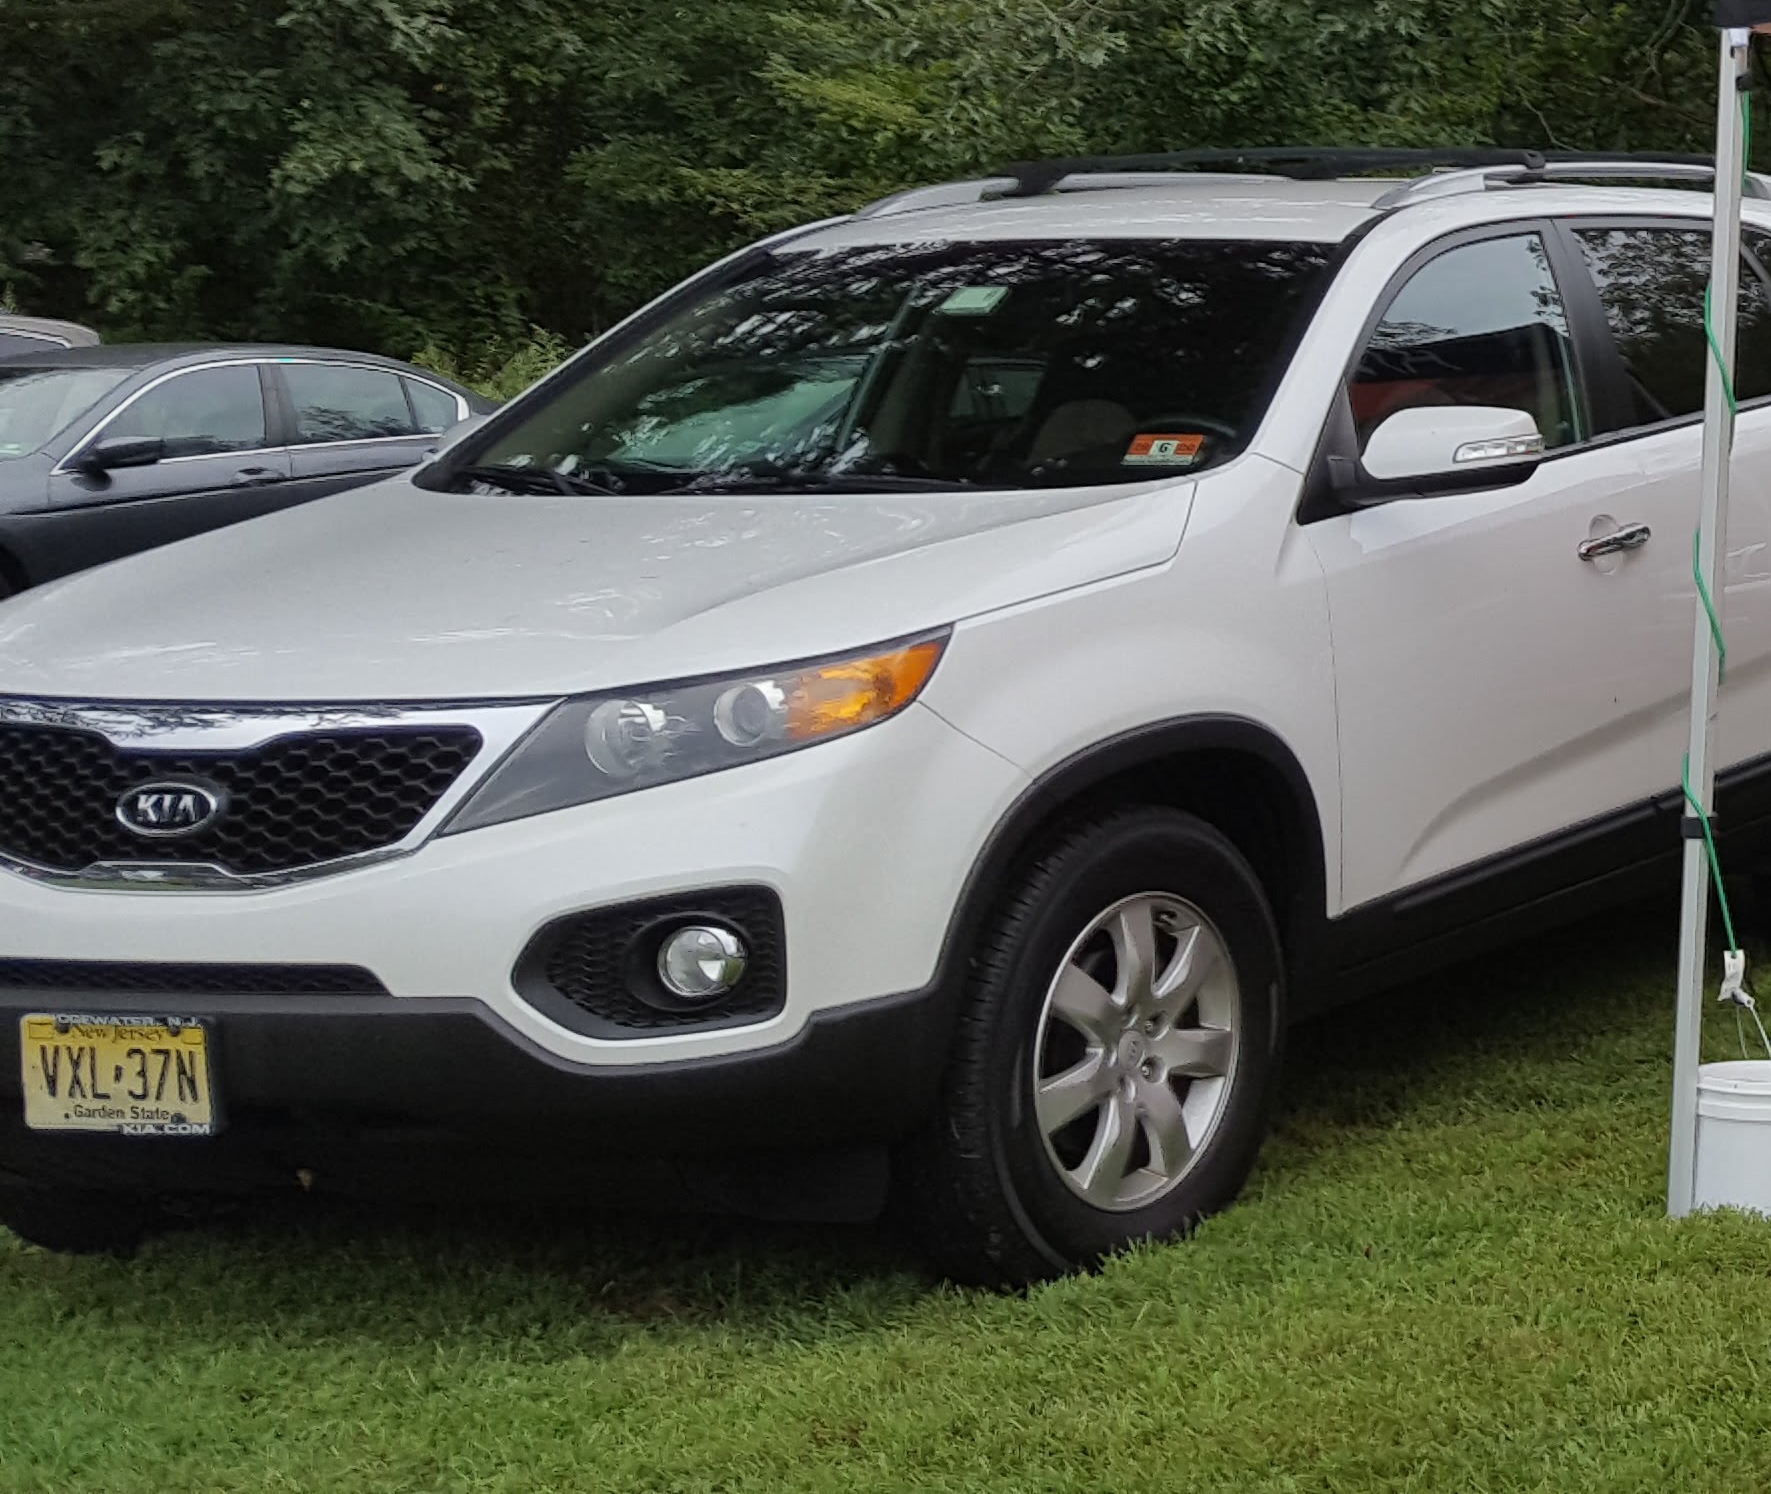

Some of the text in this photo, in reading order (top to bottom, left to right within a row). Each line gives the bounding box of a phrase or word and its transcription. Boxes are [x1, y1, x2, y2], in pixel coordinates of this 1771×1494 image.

[137, 794, 195, 822] KIA
[73, 1024, 166, 1043] New Jersey
[40, 1045, 199, 1103] VXL 37N
[73, 1105, 171, 1121] Garden State
